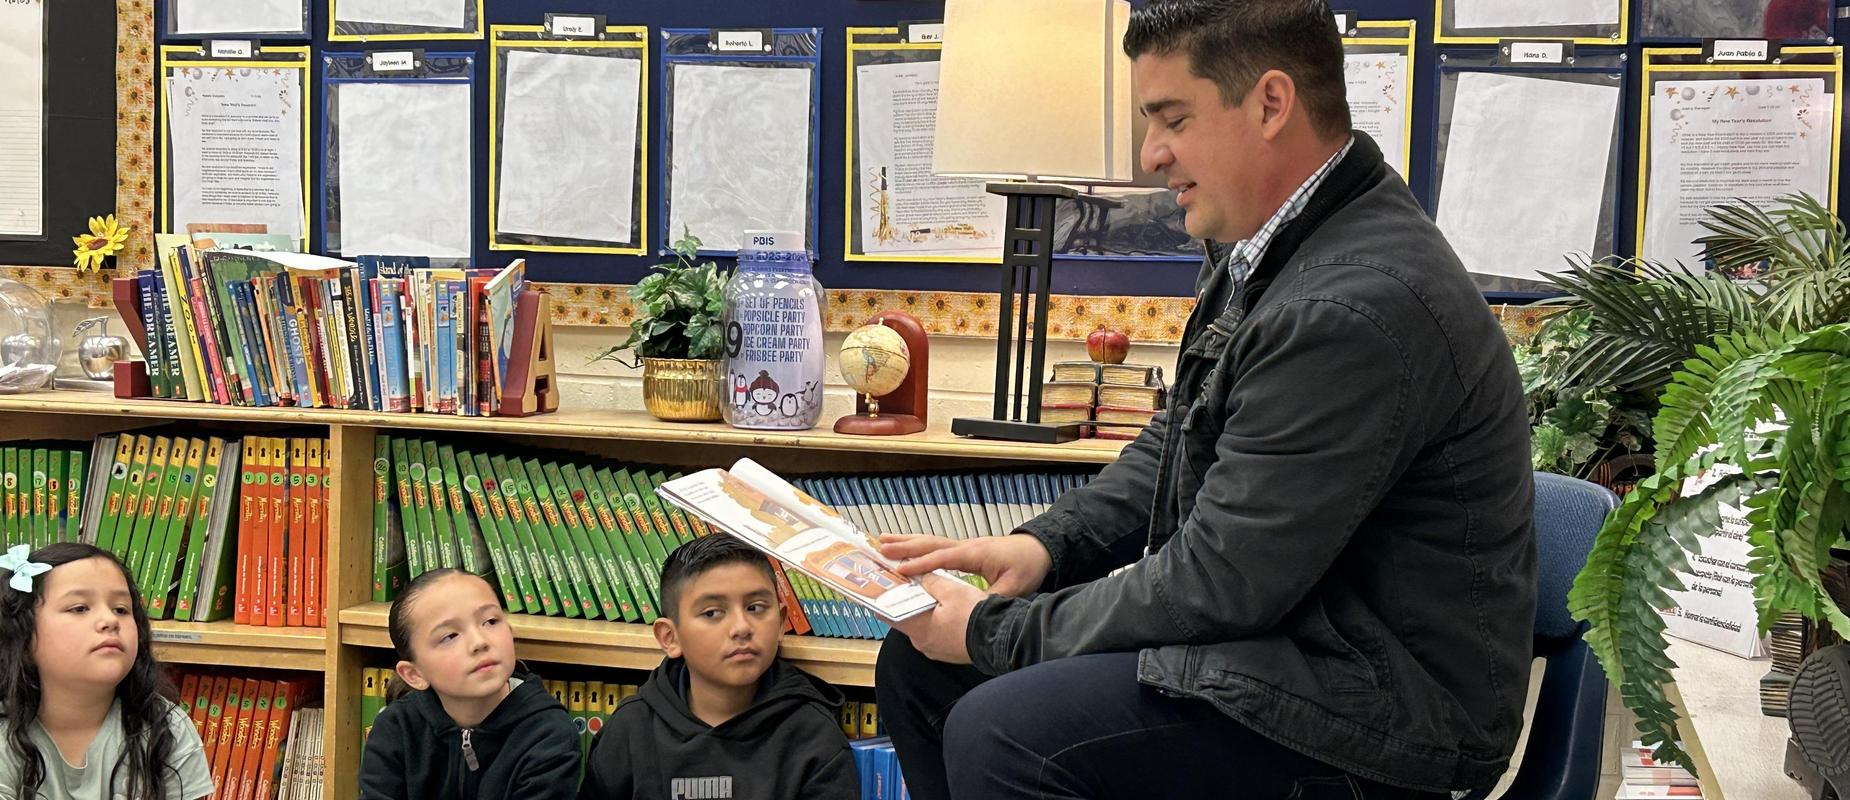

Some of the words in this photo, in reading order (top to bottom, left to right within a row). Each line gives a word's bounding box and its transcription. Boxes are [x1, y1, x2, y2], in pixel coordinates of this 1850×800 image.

[376, 260, 396, 275] Island
[398, 262, 404, 276] of
[142, 285, 154, 310] THE
[744, 298, 756, 308] SET
[772, 298, 805, 310] PENCILS
[742, 323, 778, 336] POPCORN
[780, 324, 804, 336] PARTY
[743, 310, 780, 322] POPSICLE
[782, 312, 806, 324] PARTY
[144, 314, 160, 376] DREAMER
[164, 314, 180, 376] DREAMER
[288, 319, 304, 364] GHOSTS
[744, 336, 754, 348] ICE
[756, 337, 786, 350] CREAM
[788, 338, 810, 350] PARTY
[746, 350, 777, 362] FRISBEE
[780, 350, 804, 362] PARTY
[293, 476, 300, 484] 5
[398, 478, 410, 508] Wonders
[413, 480, 425, 508] Wonders
[504, 484, 514, 492] 15
[34, 488, 44, 516] Wonders
[70, 490, 78, 518] Wonders
[430, 484, 442, 511] Wonders
[449, 484, 462, 514] Wonders
[472, 490, 487, 519] Wonders
[488, 492, 506, 520] Wonders
[506, 495, 523, 522] Wonders
[523, 496, 542, 525] Wonders
[541, 498, 561, 527] Wonders
[561, 500, 580, 528] Wonders
[579, 502, 598, 530] Wonders
[596, 504, 616, 532] Wonders
[614, 506, 634, 534] Wonders
[634, 506, 653, 535] Wonders
[652, 508, 670, 536] Wonders
[670, 509, 689, 538] Wonders
[410, 539, 418, 566] California
[425, 540, 435, 568] California
[466, 545, 476, 572] California
[494, 548, 506, 574] California
[512, 550, 526, 576] California
[530, 552, 543, 578] California
[550, 554, 564, 580] California
[568, 556, 582, 582] California
[588, 557, 602, 583] California
[606, 558, 620, 585] California
[625, 560, 640, 586] California
[644, 562, 660, 589] California
[220, 716, 232, 745] Wonders
[236, 717, 250, 748] Wonders
[251, 720, 265, 750] Wonders
[267, 719, 280, 750] Wonders
[672, 776, 732, 800] PUMA
